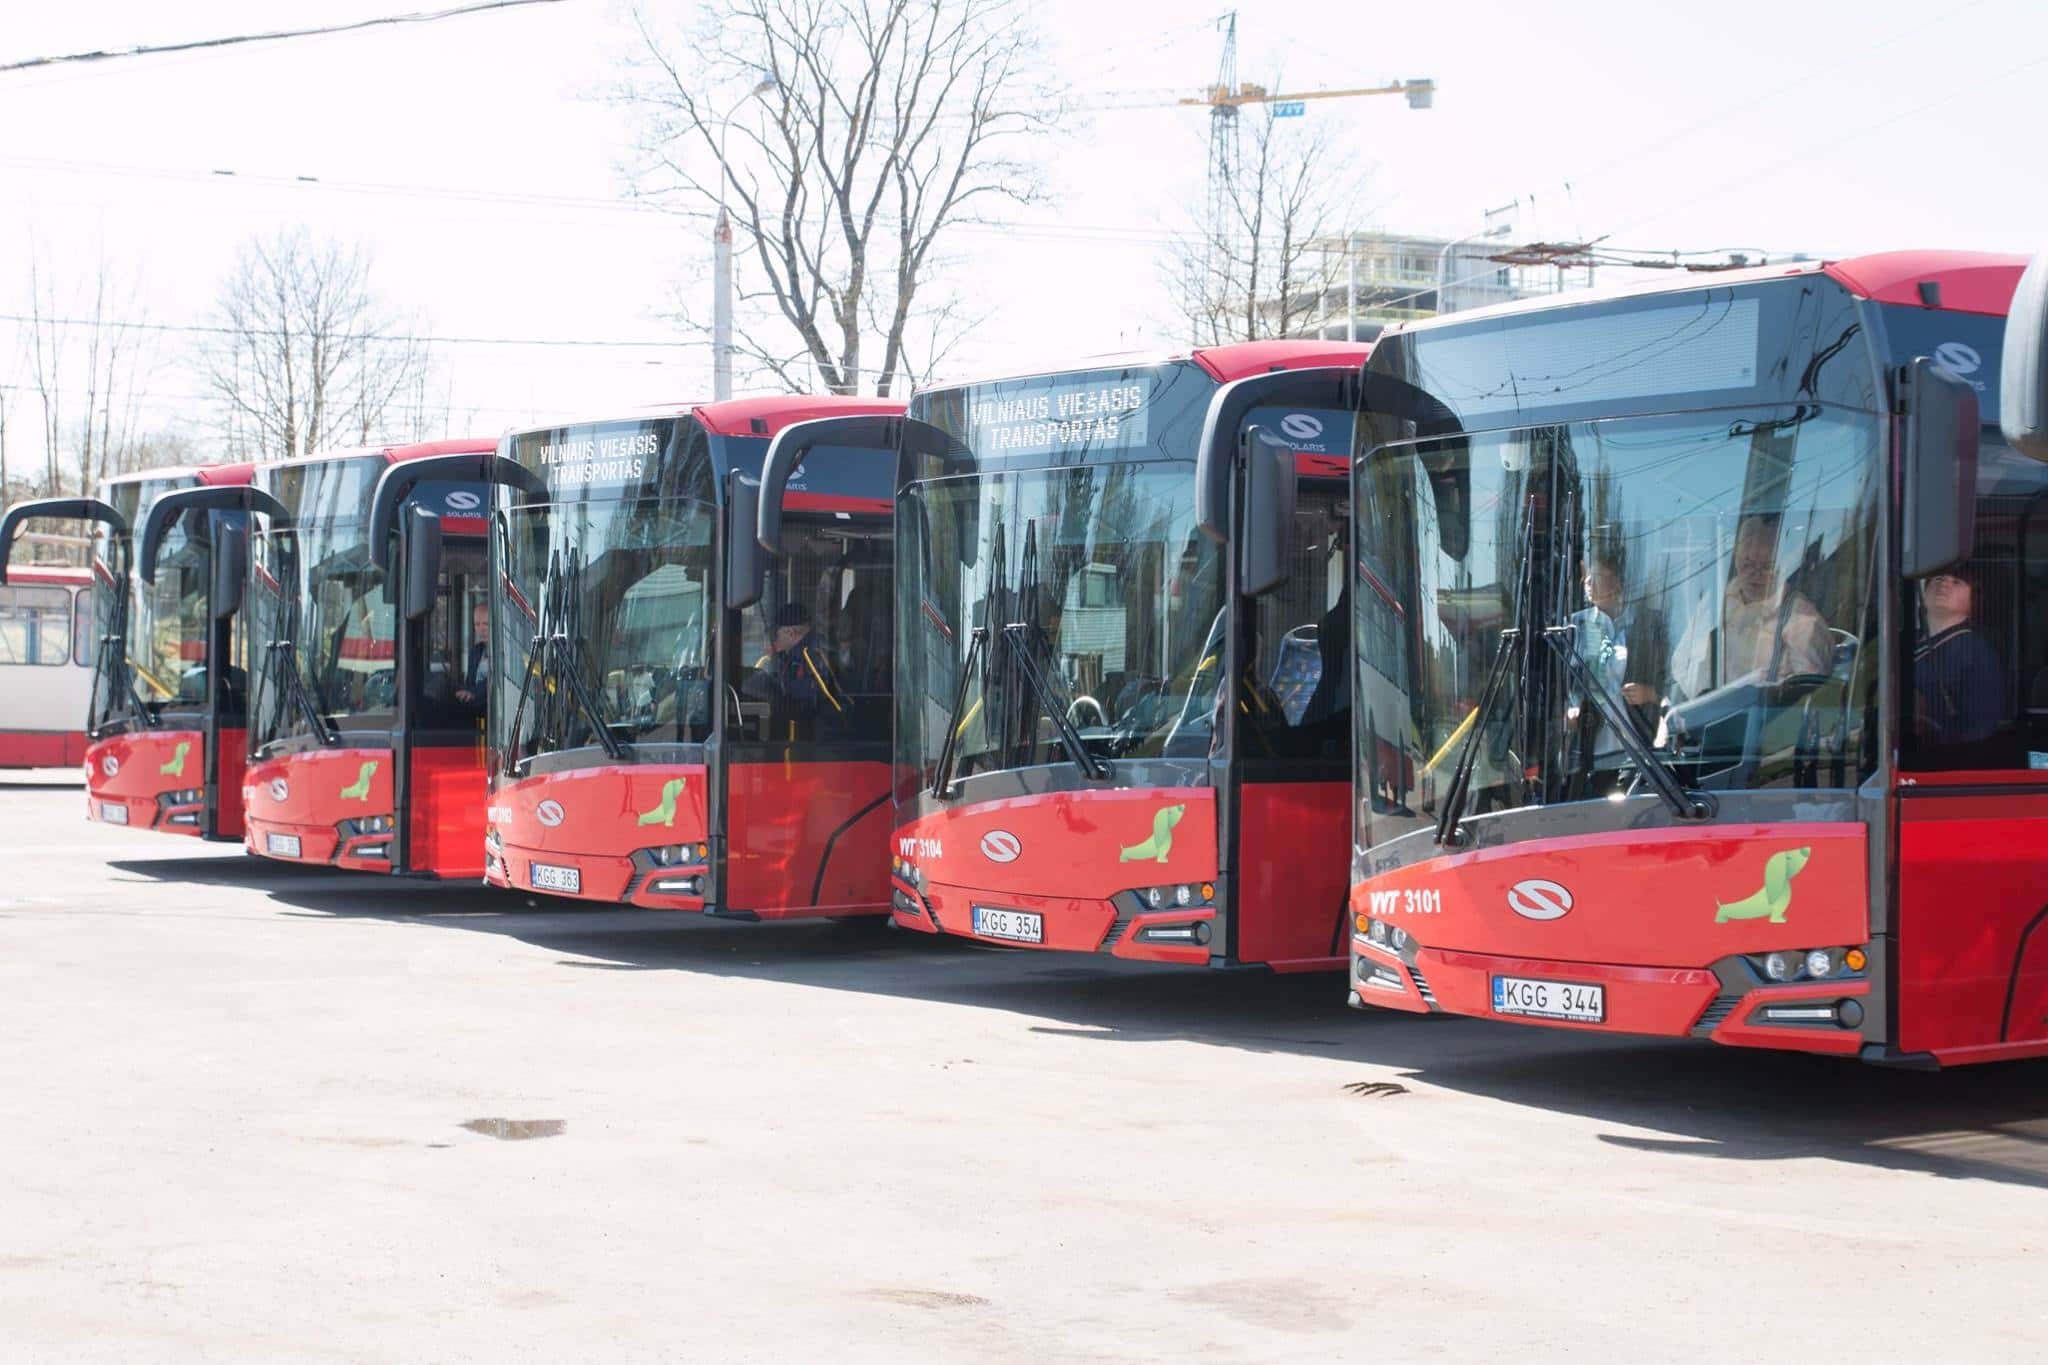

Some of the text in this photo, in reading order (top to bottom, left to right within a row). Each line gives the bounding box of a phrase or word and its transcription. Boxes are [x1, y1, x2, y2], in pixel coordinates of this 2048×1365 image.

[972, 397, 1049, 425] VILNIAUS
[991, 416, 1119, 450] TRANSPORTAS
[540, 441, 594, 464] VILNIAUS
[553, 459, 642, 485] TRANSPORTAS
[919, 838, 943, 859] 3104
[537, 868, 557, 885] KGG
[561, 871, 578, 888] 363
[1404, 888, 1441, 913] 3101
[981, 911, 1008, 932] KGG
[1016, 916, 1039, 937] 354
[1506, 981, 1599, 1014] KGG 344
